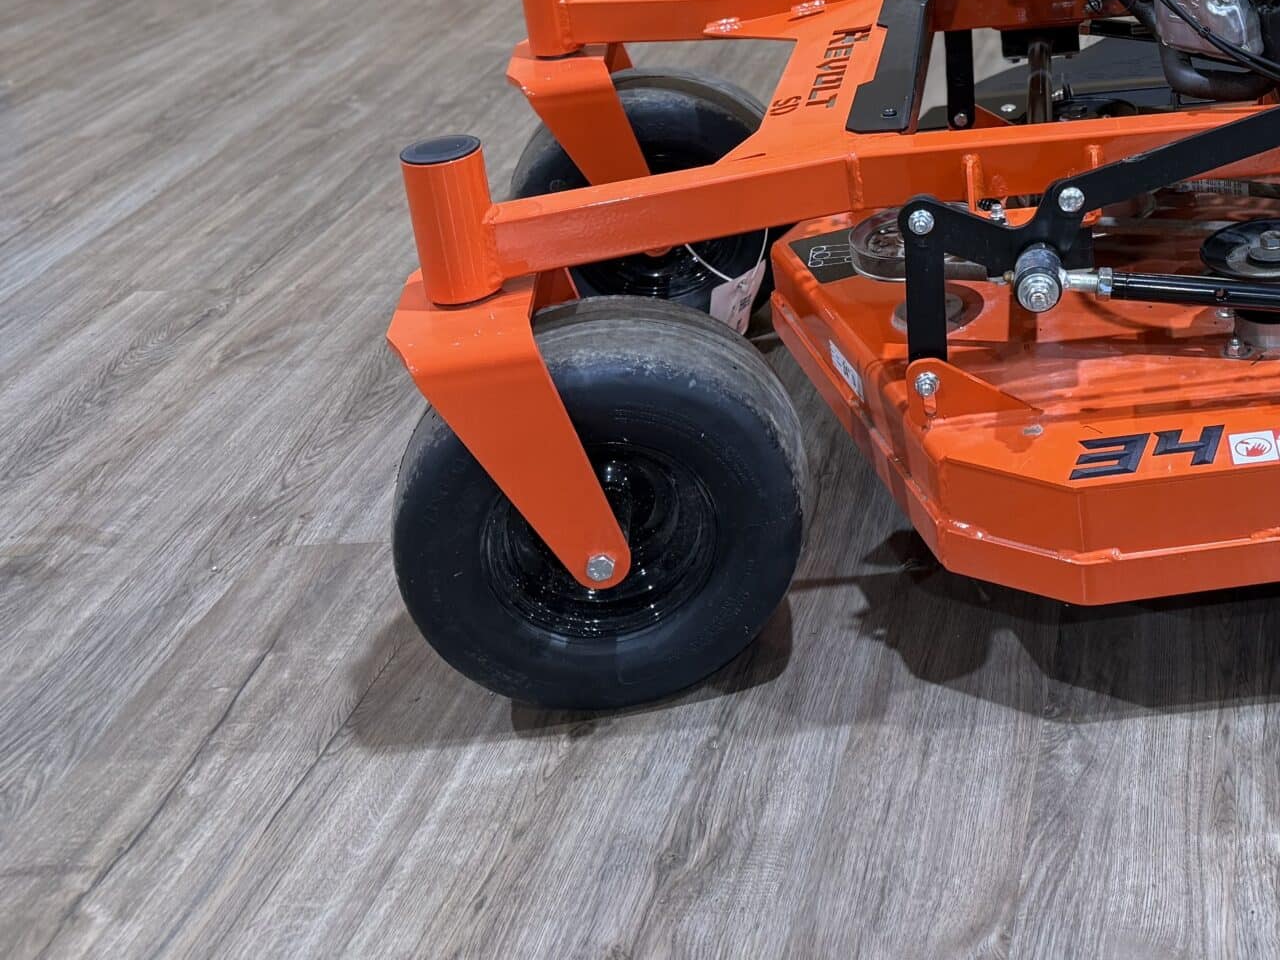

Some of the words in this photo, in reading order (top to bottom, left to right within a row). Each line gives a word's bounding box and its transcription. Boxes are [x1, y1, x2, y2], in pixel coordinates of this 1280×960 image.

[805, 23, 873, 109] REVOLT
[770, 95, 802, 117] SD
[1069, 424, 1225, 480] 34
